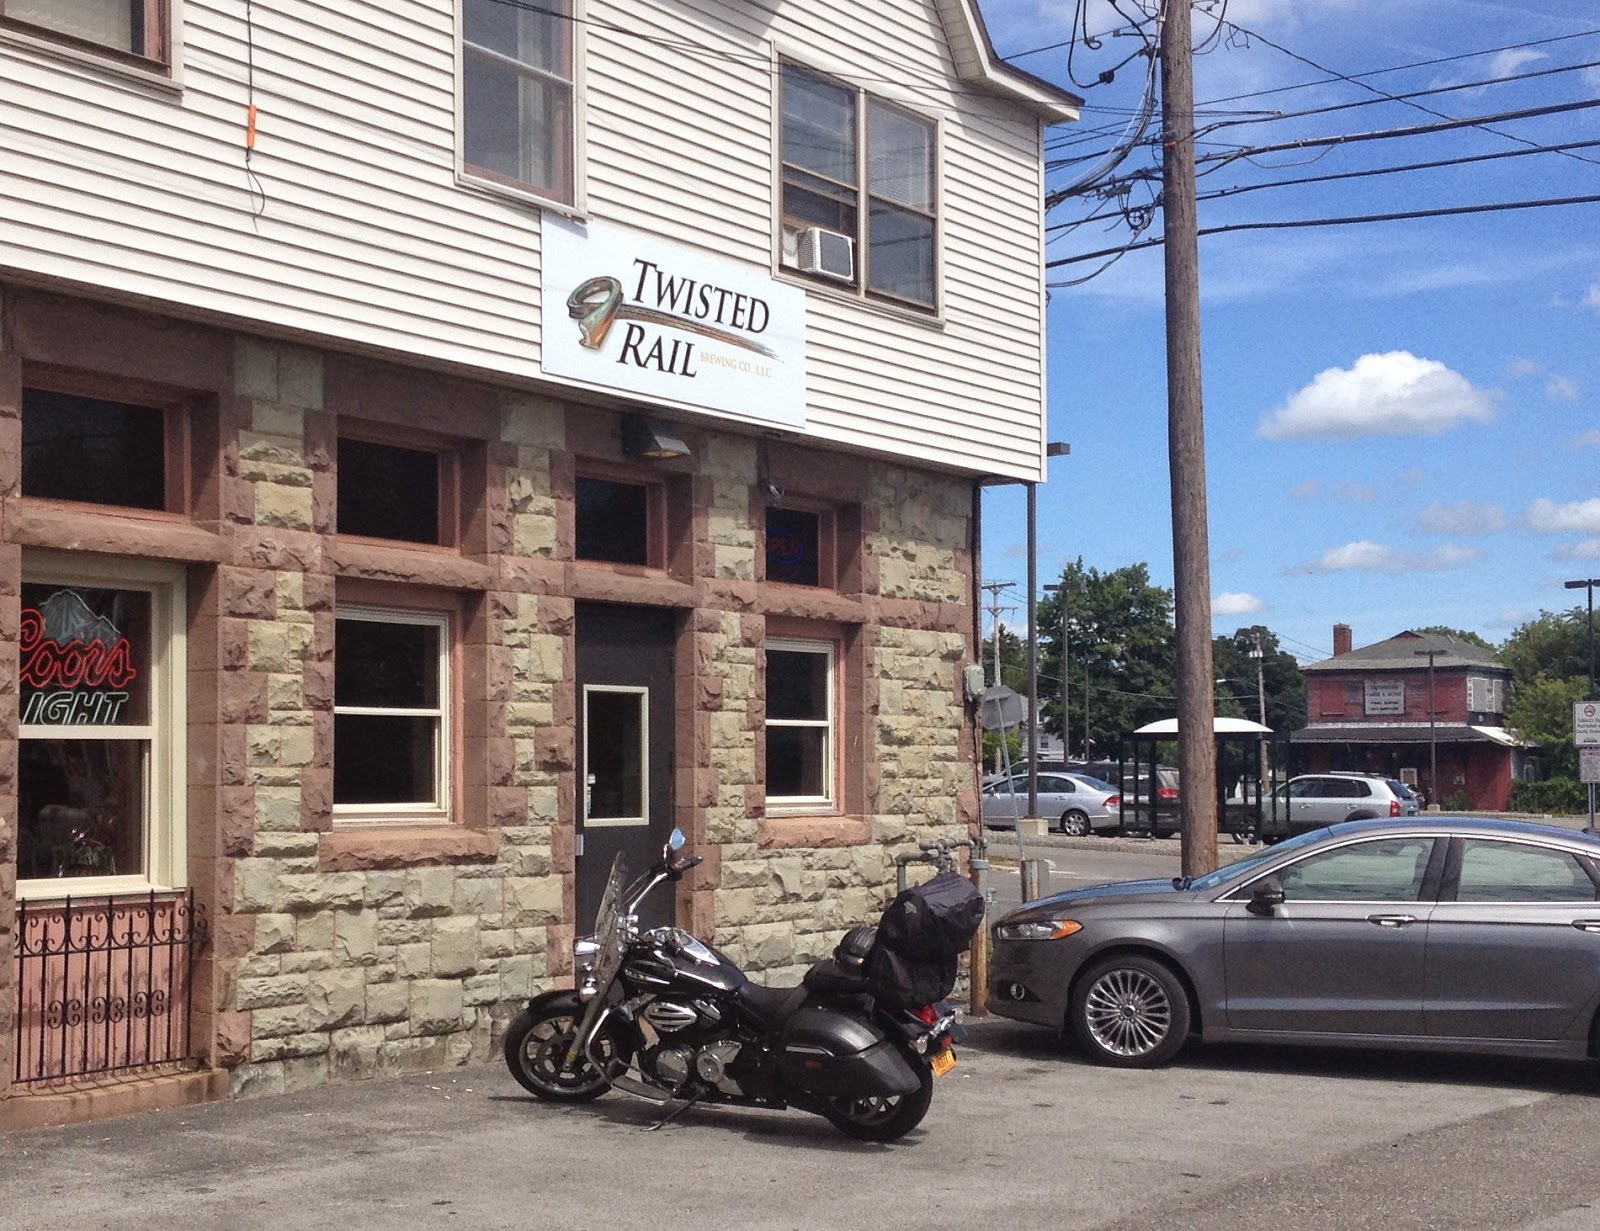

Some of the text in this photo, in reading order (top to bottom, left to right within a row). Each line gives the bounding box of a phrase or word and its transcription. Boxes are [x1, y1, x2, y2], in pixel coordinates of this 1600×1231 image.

[633, 257, 770, 334] TWISTED
[616, 322, 698, 378] RAIL
[700, 351, 772, 378] BREWING CO. LLC
[21, 691, 129, 725] IGHT
